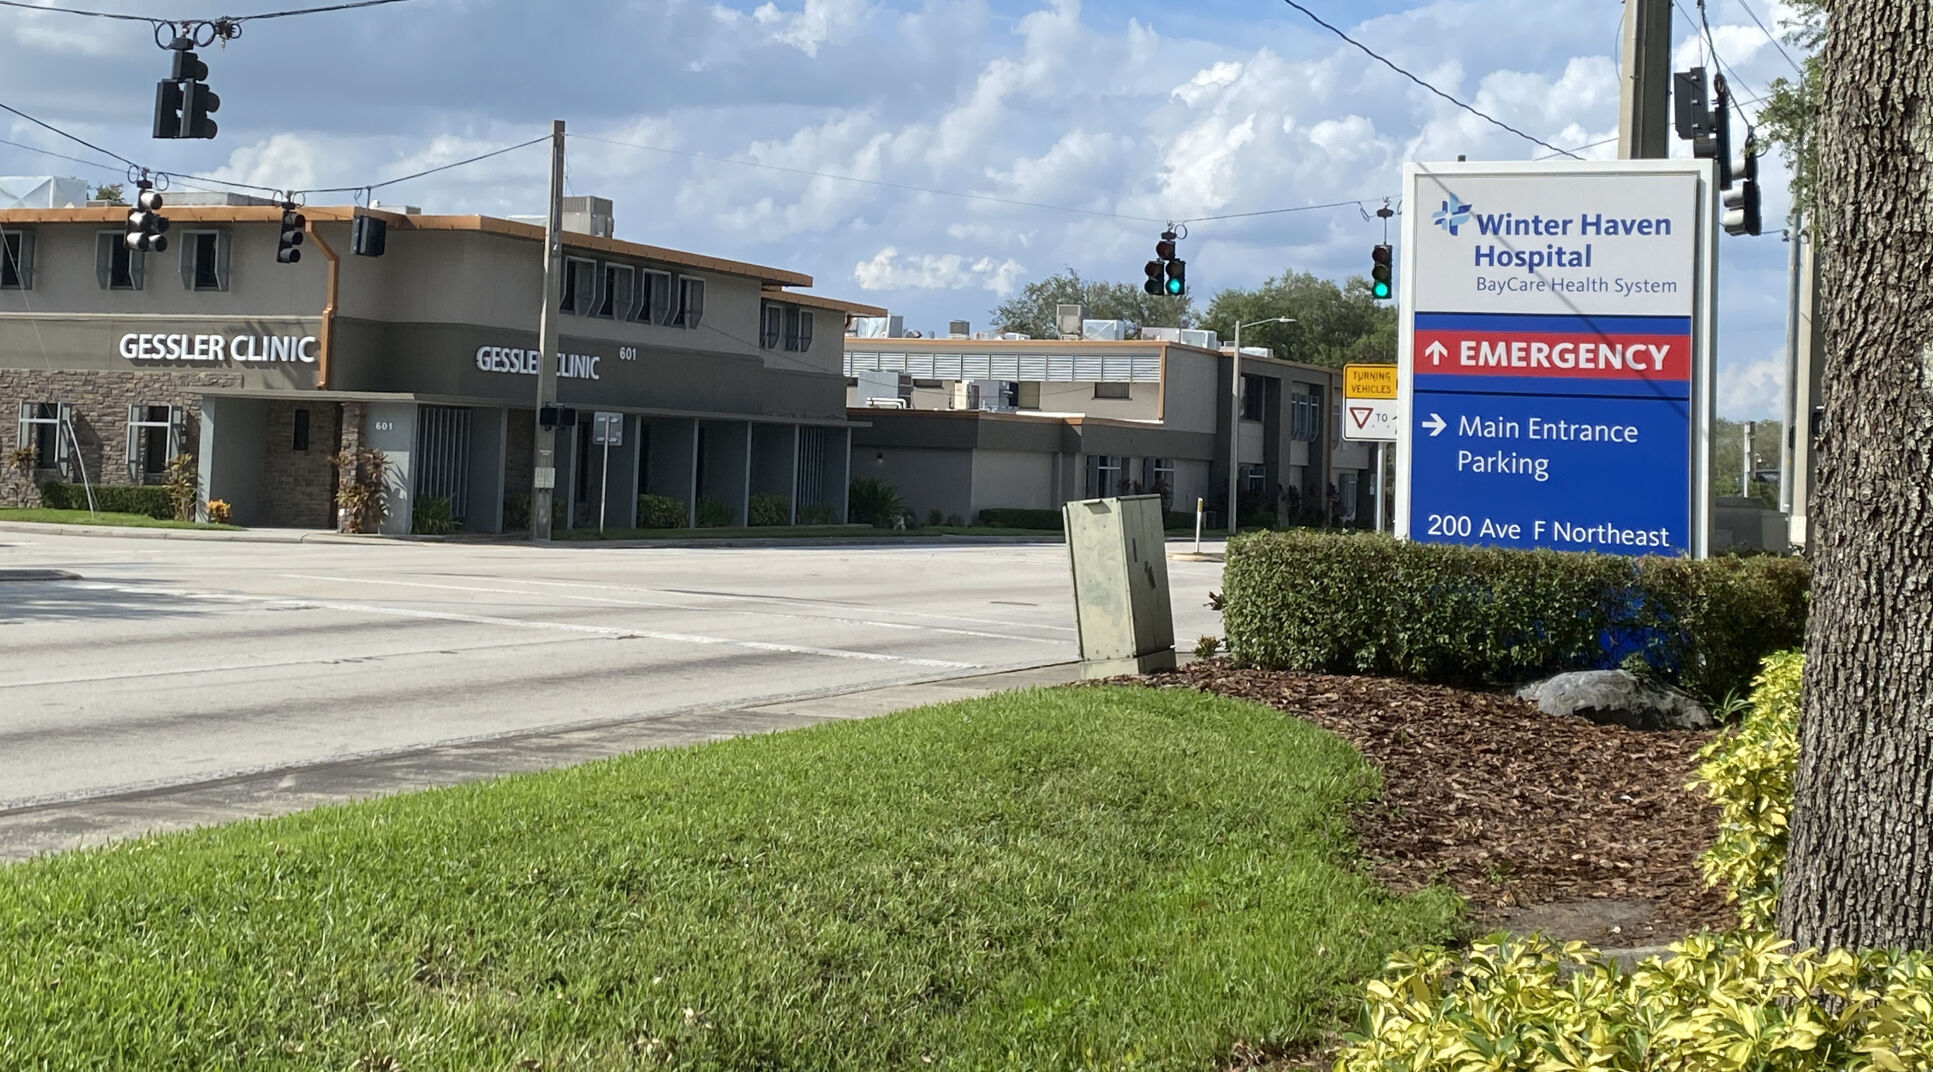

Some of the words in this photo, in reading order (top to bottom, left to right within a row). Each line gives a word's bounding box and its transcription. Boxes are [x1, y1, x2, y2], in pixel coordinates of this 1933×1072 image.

[1476, 212, 1573, 236] Winter
[1581, 213, 1671, 236] Haven
[1474, 243, 1592, 274] Hospital
[1476, 276, 1546, 295] BayCare
[1551, 276, 1609, 293] Health
[1614, 278, 1677, 297] System
[119, 333, 226, 362] GESSLER
[230, 335, 316, 363] CLINIC
[476, 346, 543, 375] GESSLE
[619, 346, 637, 361] 601
[1460, 341, 1671, 371] EMERGENCY
[1353, 371, 1391, 381] TURNING
[1351, 385, 1391, 394] VEHICLES
[375, 421, 393, 431] 601
[1376, 413, 1388, 423] TO
[1458, 415, 1519, 438] Main
[1528, 417, 1639, 443] Entrance
[1457, 450, 1550, 481] Parking
[1427, 514, 1472, 537] 200
[1479, 518, 1521, 540] Ave
[1534, 520, 1546, 540] F
[1554, 521, 1670, 547] Northeast
